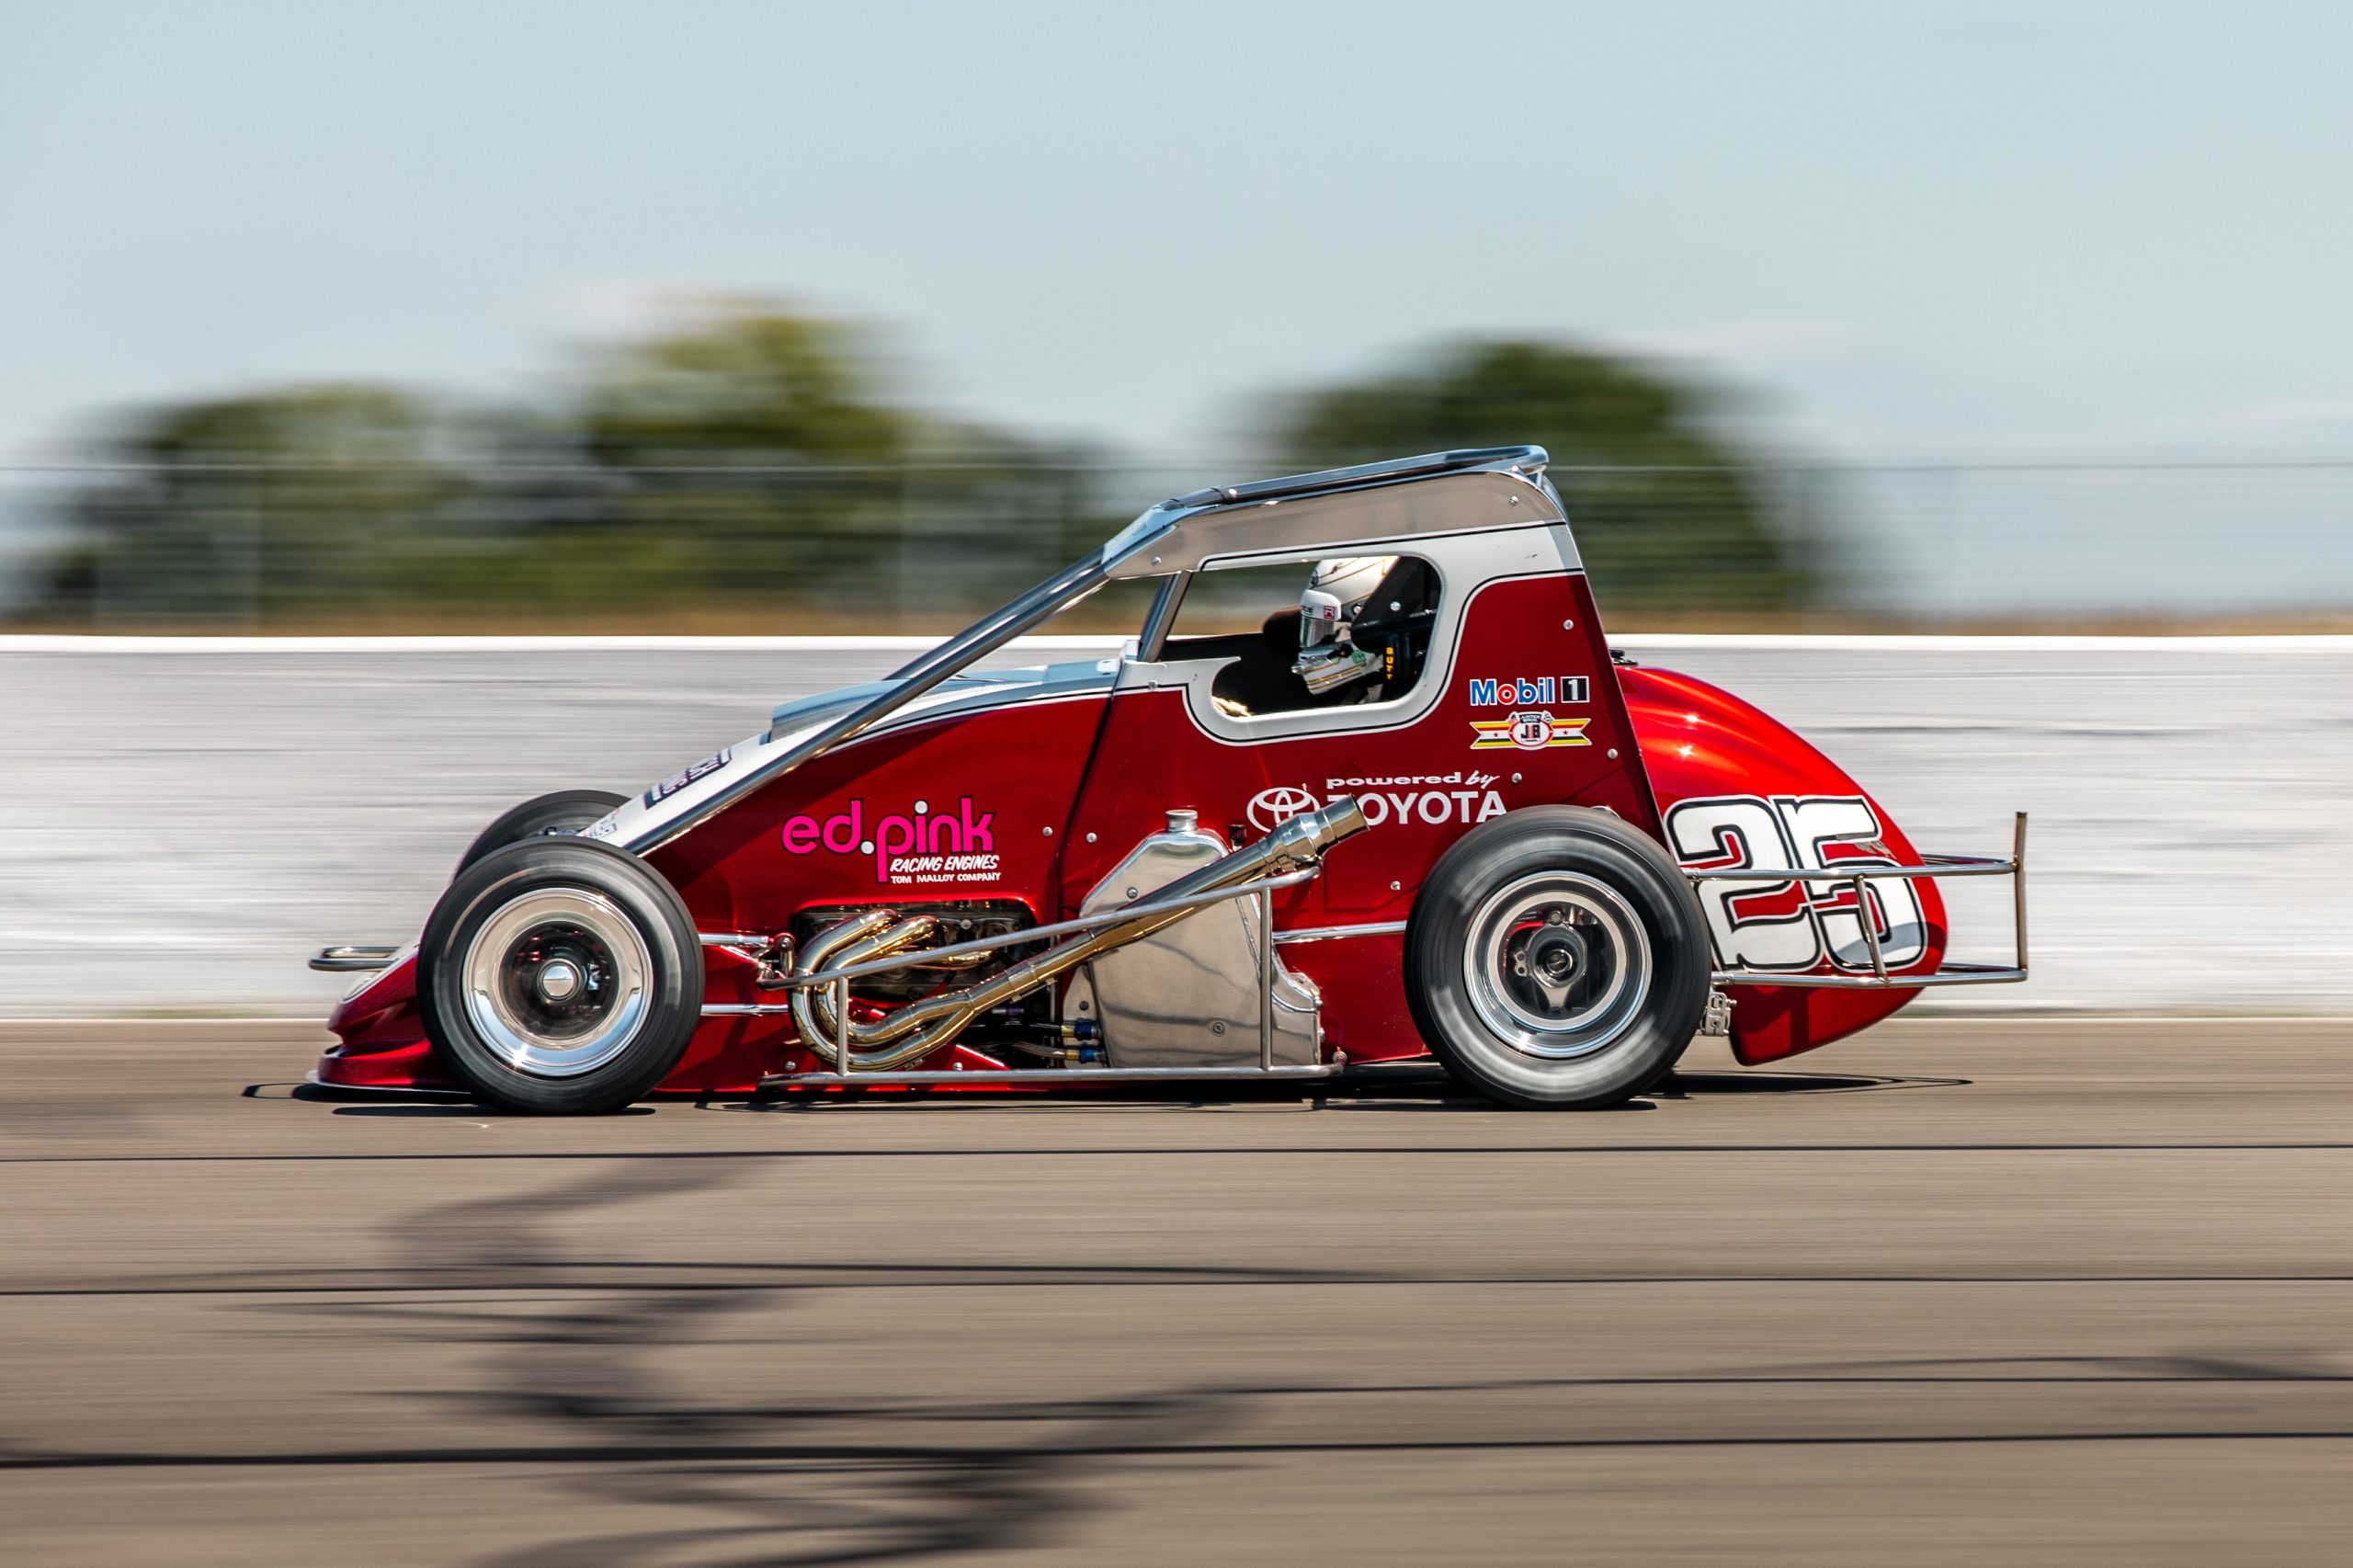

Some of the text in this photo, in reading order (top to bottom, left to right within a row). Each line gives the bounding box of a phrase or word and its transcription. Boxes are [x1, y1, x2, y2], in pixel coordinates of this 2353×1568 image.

[1470, 676, 1555, 706] Mobil
[1326, 770, 1500, 789] powered by
[890, 855, 1000, 872] RACING ENGINES
[891, 871, 1001, 884] TOM MALLOY COMPANY
[1664, 794, 1927, 972] 25
